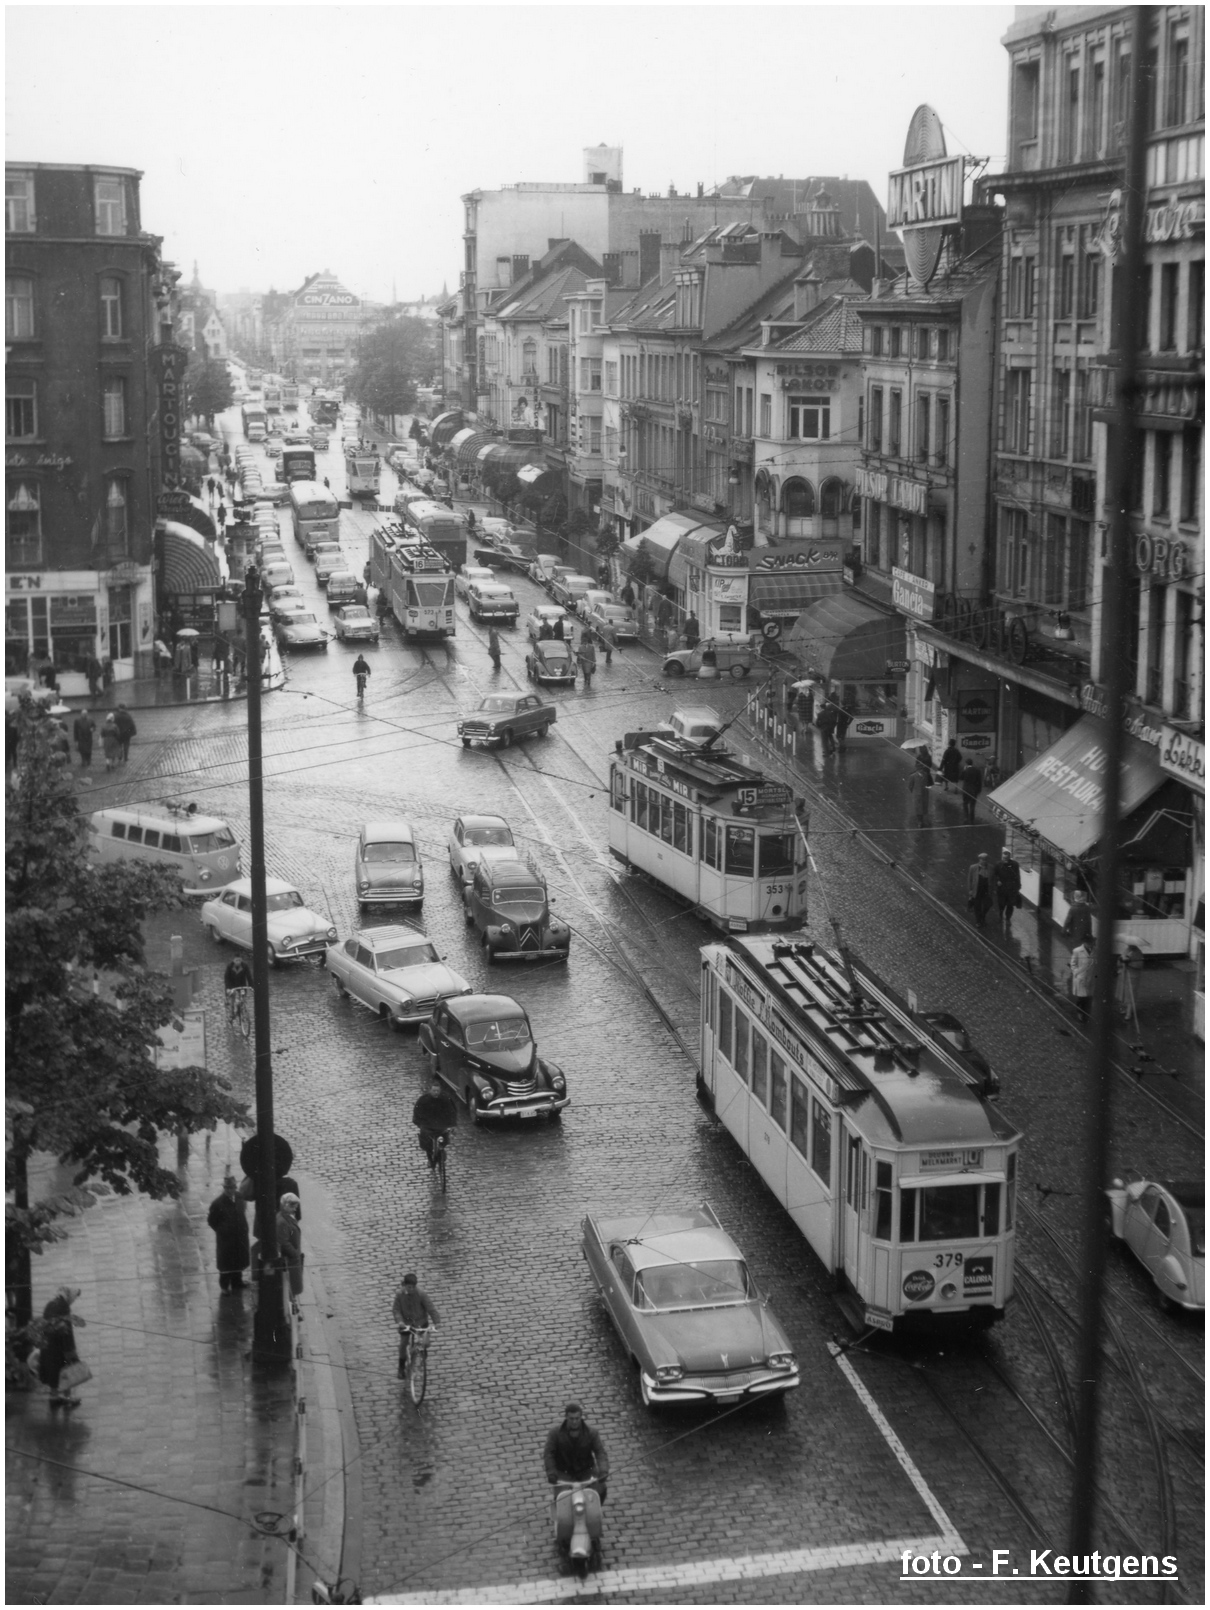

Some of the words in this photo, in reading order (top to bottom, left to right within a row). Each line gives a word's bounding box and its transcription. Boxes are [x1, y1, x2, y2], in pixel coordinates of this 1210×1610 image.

[889, 162, 958, 225] MARTINI
[304, 294, 352, 306] CINZANO
[756, 548, 821, 571] SNACK
[1132, 532, 1187, 579] ORG
[893, 579, 923, 615] Gancia
[962, 707, 991, 715] MARTINI
[857, 724, 883, 733] Gancia
[962, 738, 990, 747] Gancia
[741, 789, 755, 804] 15
[766, 884, 784, 895] 353
[922, 1157, 962, 1166] MELKMARKT
[935, 1252, 964, 1268] 379
[963, 1273, 993, 1285] CALORIA
[867, 1315, 891, 1329] ASPRO
